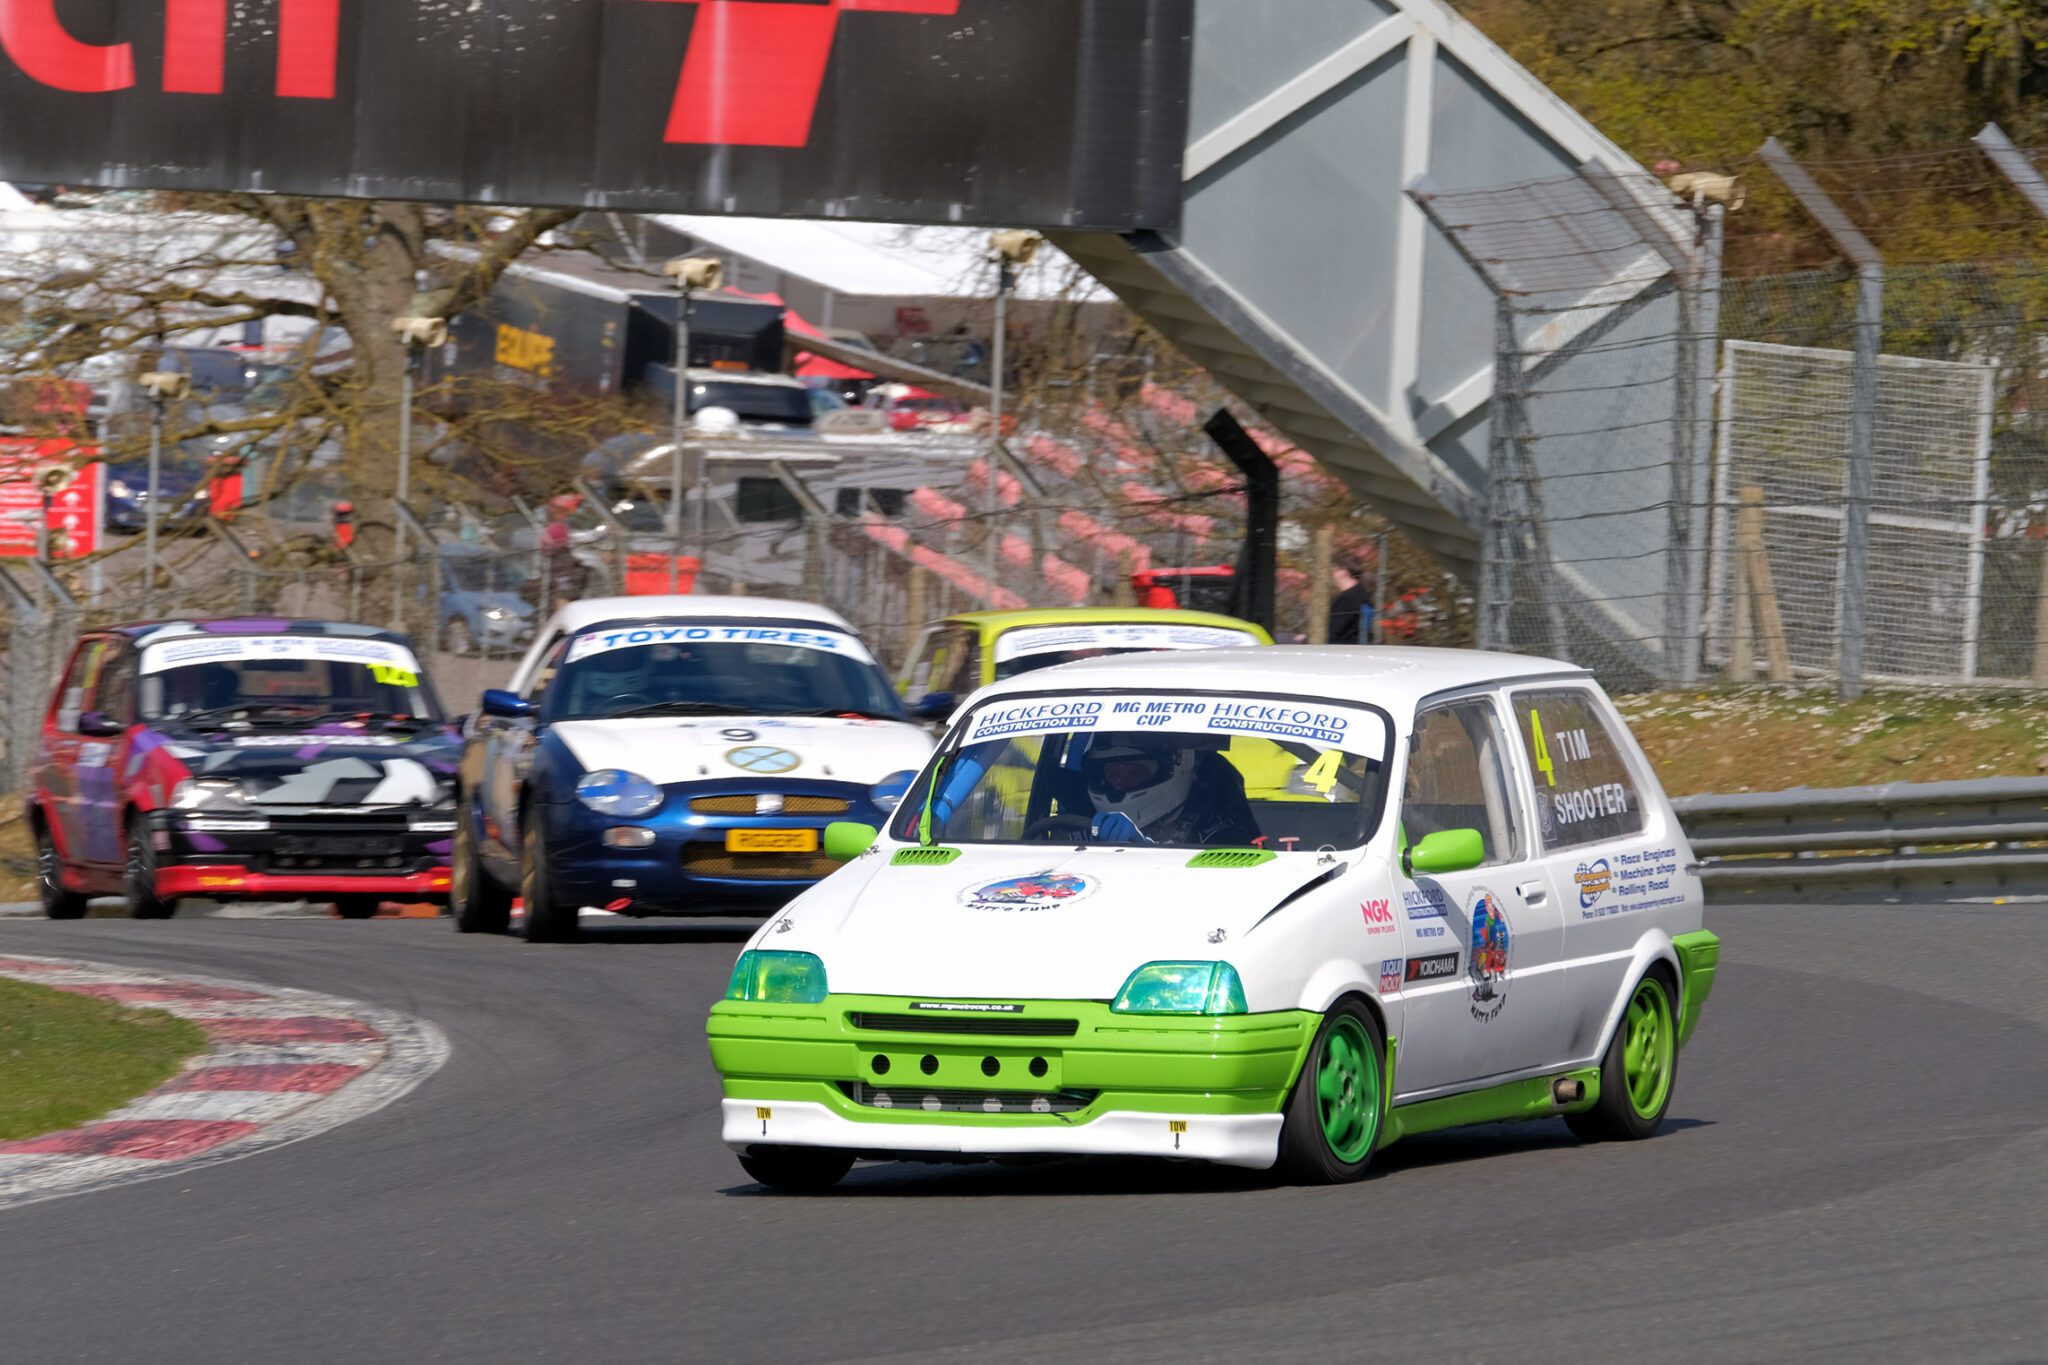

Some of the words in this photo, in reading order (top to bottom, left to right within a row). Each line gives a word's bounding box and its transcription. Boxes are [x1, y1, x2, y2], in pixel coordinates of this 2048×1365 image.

[603, 628, 710, 647] TOYO
[979, 702, 1102, 728] HICKFORD
[1113, 702, 1141, 714] MG
[1145, 702, 1206, 715] METRO
[1213, 703, 1349, 730] HICKFORD
[1136, 714, 1172, 726] CUP
[720, 728, 758, 742] 9
[976, 717, 1071, 736] CONSTRUCTION
[1072, 716, 1096, 727] LTD
[1211, 717, 1315, 737] CONSTRUCTION
[1317, 729, 1342, 743] LTD
[1531, 709, 1555, 786] 4
[1556, 728, 1591, 762] TIM
[1303, 749, 1344, 793] 4
[1554, 783, 1628, 824] SHOOTER
[1620, 854, 1641, 865] Race
[1643, 848, 1676, 862] Engines
[1620, 867, 1653, 880] Machine
[1656, 863, 1676, 875] shop
[1618, 883, 1646, 896] Rolling
[1648, 878, 1669, 891] Road
[1402, 889, 1444, 907] HICKFORD
[1360, 899, 1393, 924] NGK
[1381, 924, 1396, 934] PLUGS
[1382, 959, 1402, 975] LIQUI
[1420, 957, 1456, 977] YOKOHAMA
[1380, 977, 1400, 992] MOLY
[756, 1106, 772, 1119] TOW
[1169, 1120, 1187, 1132] TOW
